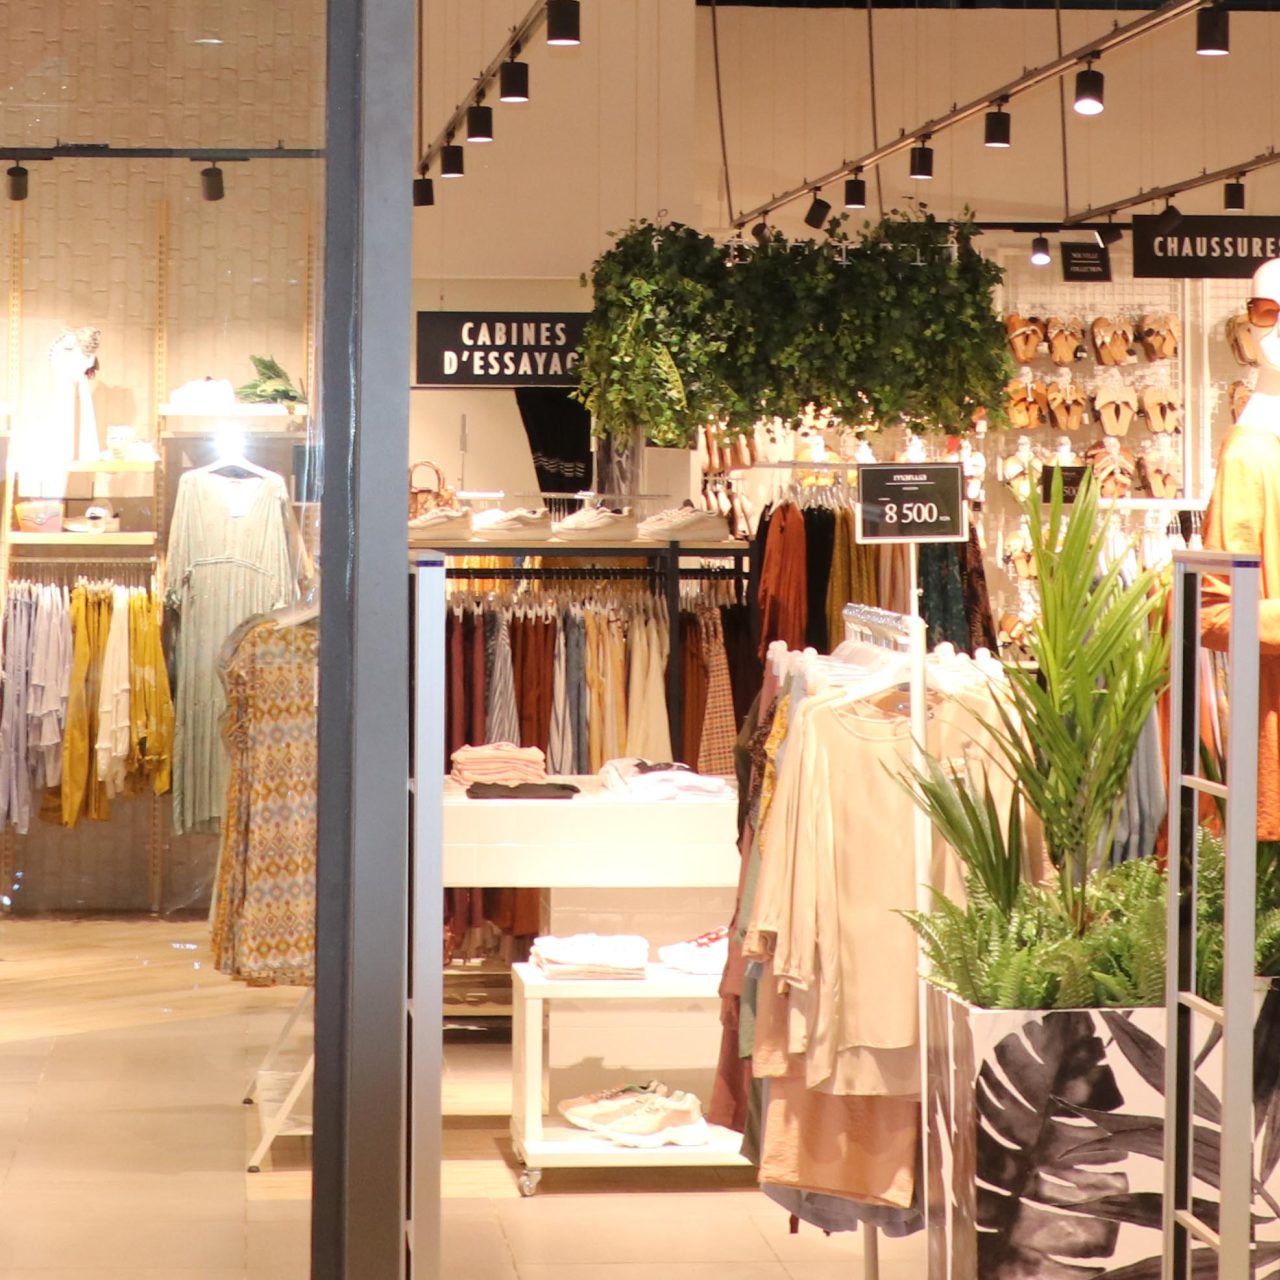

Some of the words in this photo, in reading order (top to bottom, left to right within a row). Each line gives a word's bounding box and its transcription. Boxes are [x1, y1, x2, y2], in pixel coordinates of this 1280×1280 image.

[461, 322, 567, 346] CABINES
[443, 351, 581, 376] D'ESSAYAG
[884, 503, 898, 523] 8
[901, 503, 938, 523] 500
